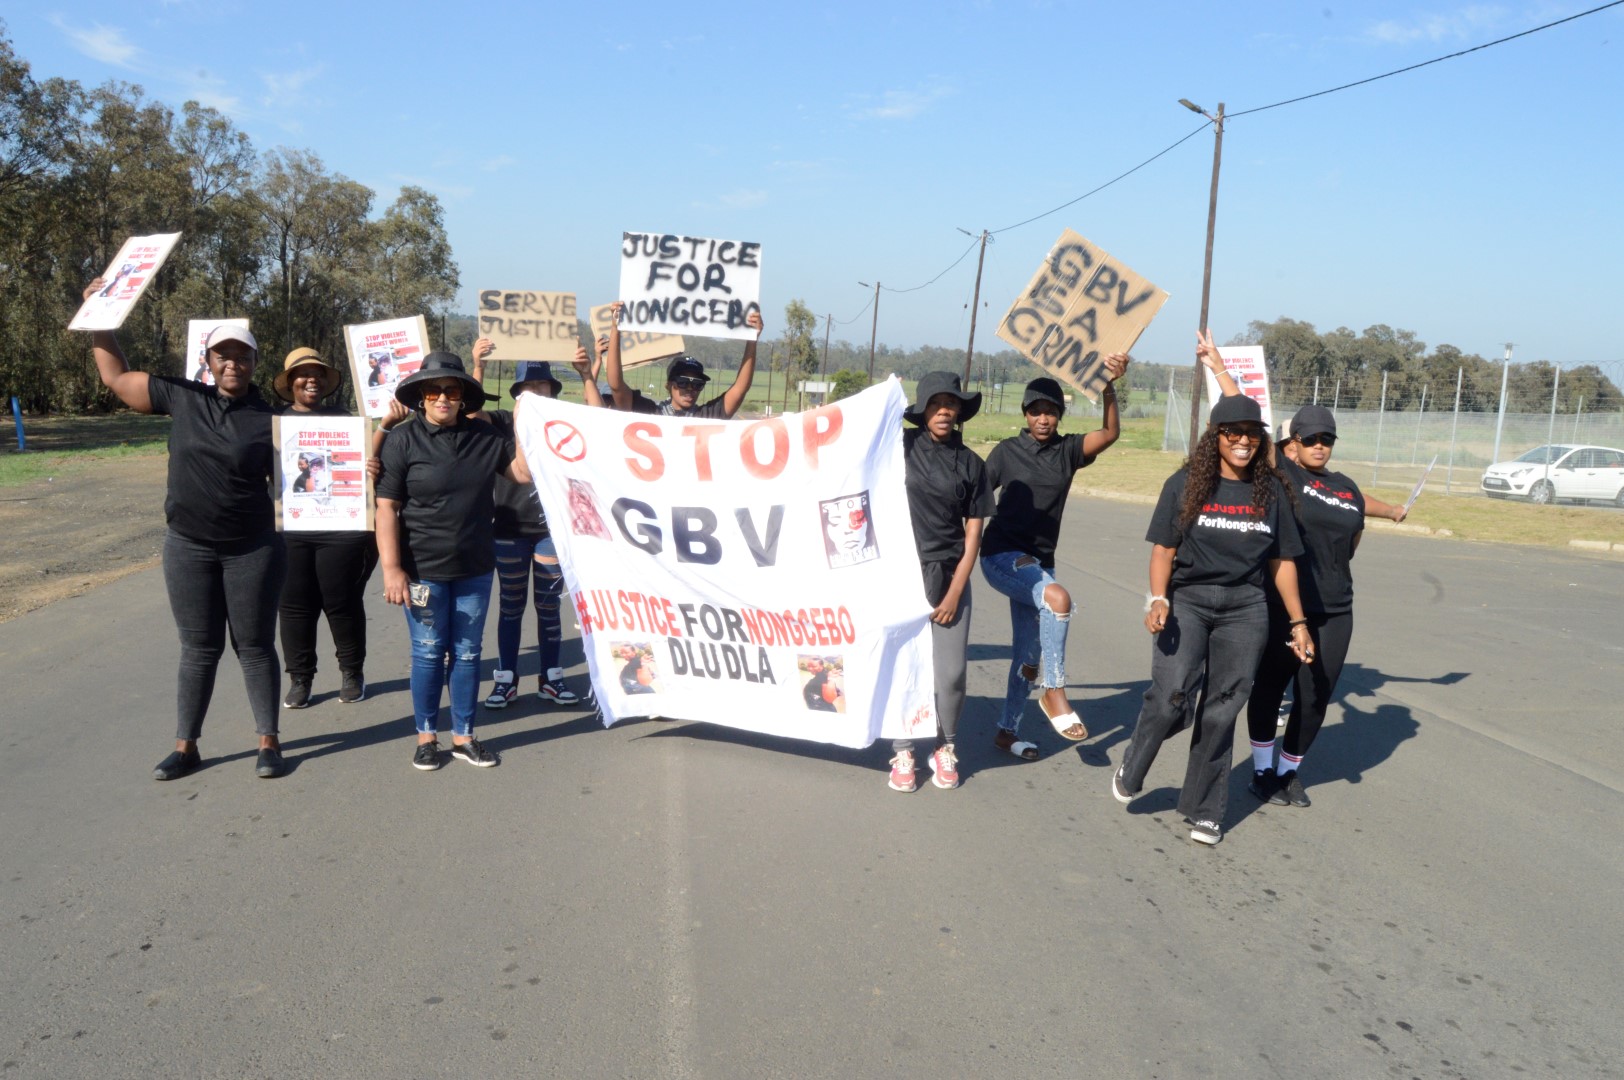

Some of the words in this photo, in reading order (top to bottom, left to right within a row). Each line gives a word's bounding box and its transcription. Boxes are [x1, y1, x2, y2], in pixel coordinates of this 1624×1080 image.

[622, 232, 761, 268] JUSTICE
[645, 261, 732, 295] FOR
[1050, 243, 1155, 316] GBV
[480, 290, 576, 316] SERVE
[365, 335, 380, 343] STOP
[381, 330, 407, 340] VIOLENCE
[480, 315, 578, 340] JUSTICE
[1068, 307, 1098, 343] A
[298, 431, 317, 439] STOP
[317, 431, 350, 439] VIOLENCE
[298, 439, 325, 447] AGAINST
[326, 439, 351, 447] WOMEN
[622, 404, 844, 482] STOP
[610, 496, 786, 568] GBV
